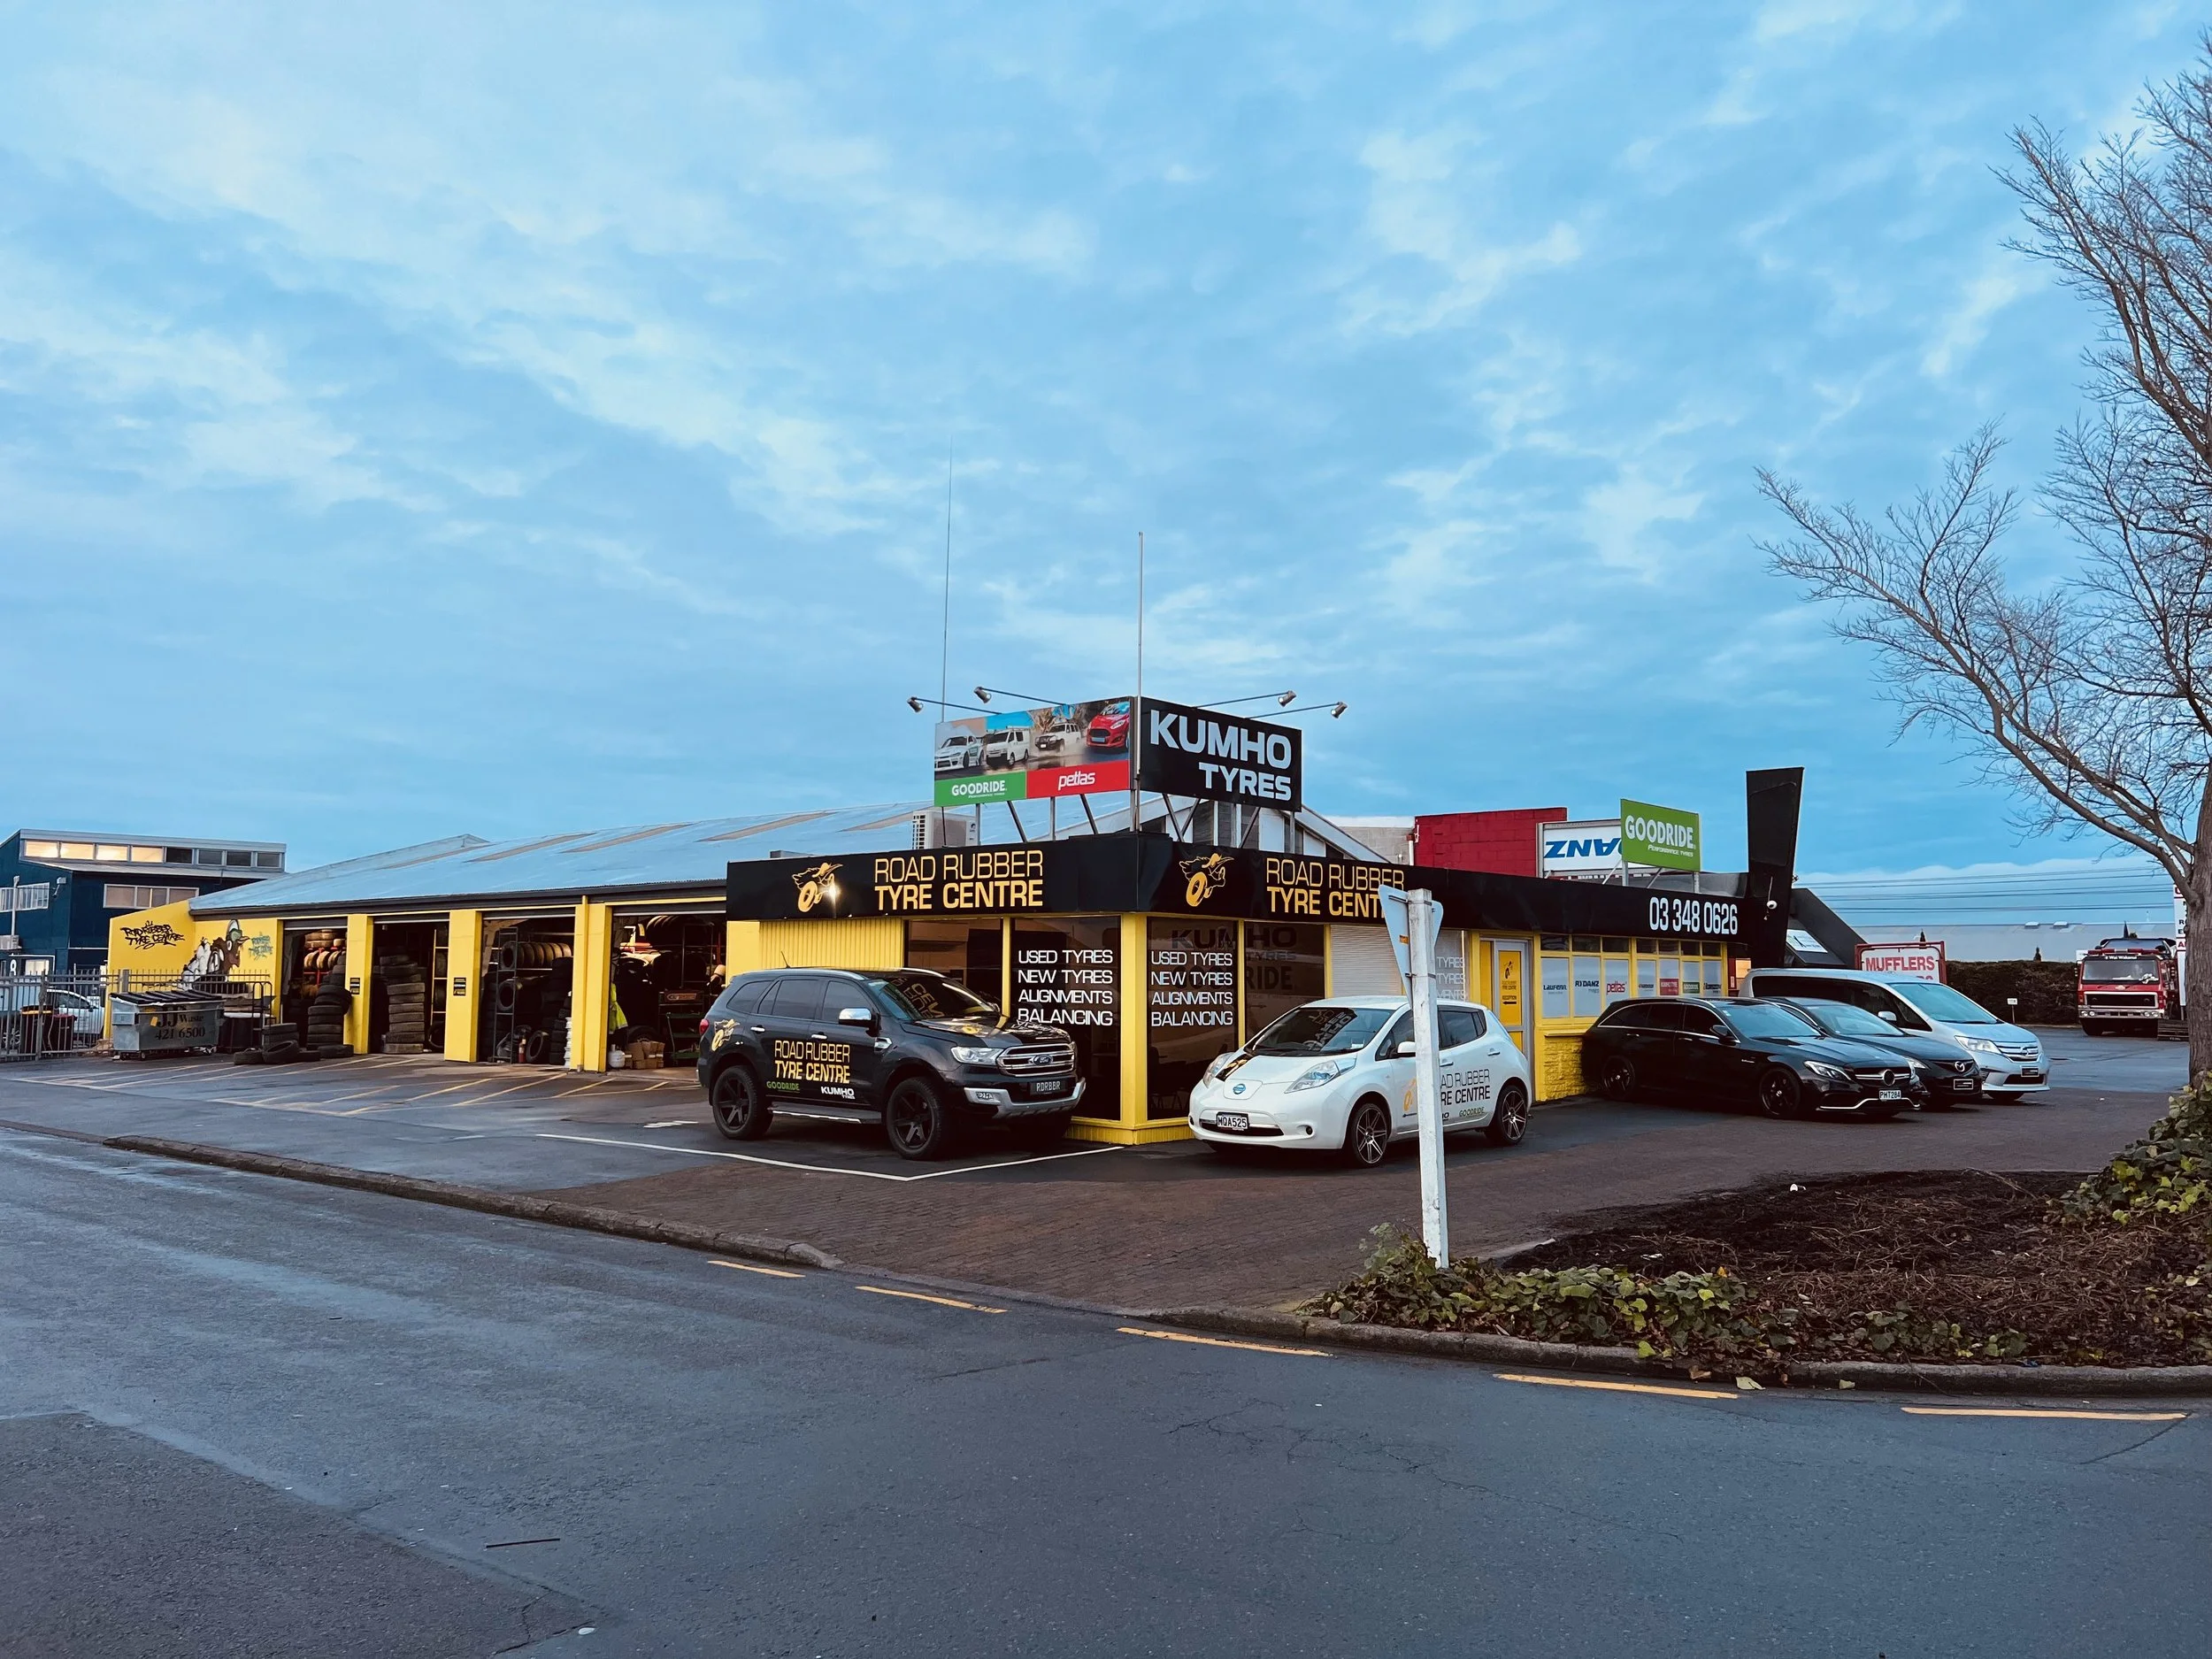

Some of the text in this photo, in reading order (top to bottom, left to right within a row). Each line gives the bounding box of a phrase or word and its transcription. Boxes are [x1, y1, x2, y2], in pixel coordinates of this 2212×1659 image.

[1150, 710, 1292, 770] KUMHO
[951, 780, 1006, 796] GOODRIDE
[1058, 771, 1096, 790] petlas
[1199, 762, 1292, 802] TYRES
[1625, 815, 1694, 849] GOODRIDE
[1543, 837, 1622, 859] ANZ
[874, 849, 1043, 883] ROAD RUBBER
[1266, 857, 1405, 891] ROAD RUBBER
[874, 879, 1043, 910] TYRE CENTRE
[1266, 886, 1385, 918] TYRE CENT
[1649, 896, 1738, 935] 03 348 0626
[1018, 949, 1113, 964] USED TYRES
[1151, 951, 1233, 967] USED TYRES
[1865, 956, 1935, 972] MUFFLERS
[1018, 970, 1113, 984] NEW TYRES
[1151, 972, 1233, 986] NEW TYRES
[1018, 989, 1113, 1004] ALIGNMENTS
[1151, 991, 1233, 1005] ALIGNMENTS
[1018, 1009, 1113, 1025] BALANCING
[1151, 1010, 1233, 1026] BALANCING
[154, 1026, 206, 1041] 421 6500
[775, 1041, 849, 1063] ROAD RUBBER
[775, 1060, 850, 1084] TYRE CENTRE
[1455, 1069, 1491, 1087] RUBBER
[766, 1081, 801, 1091] GOODRIDE
[821, 1087, 855, 1096] KUMHO
[1455, 1086, 1491, 1104] CENTRE
